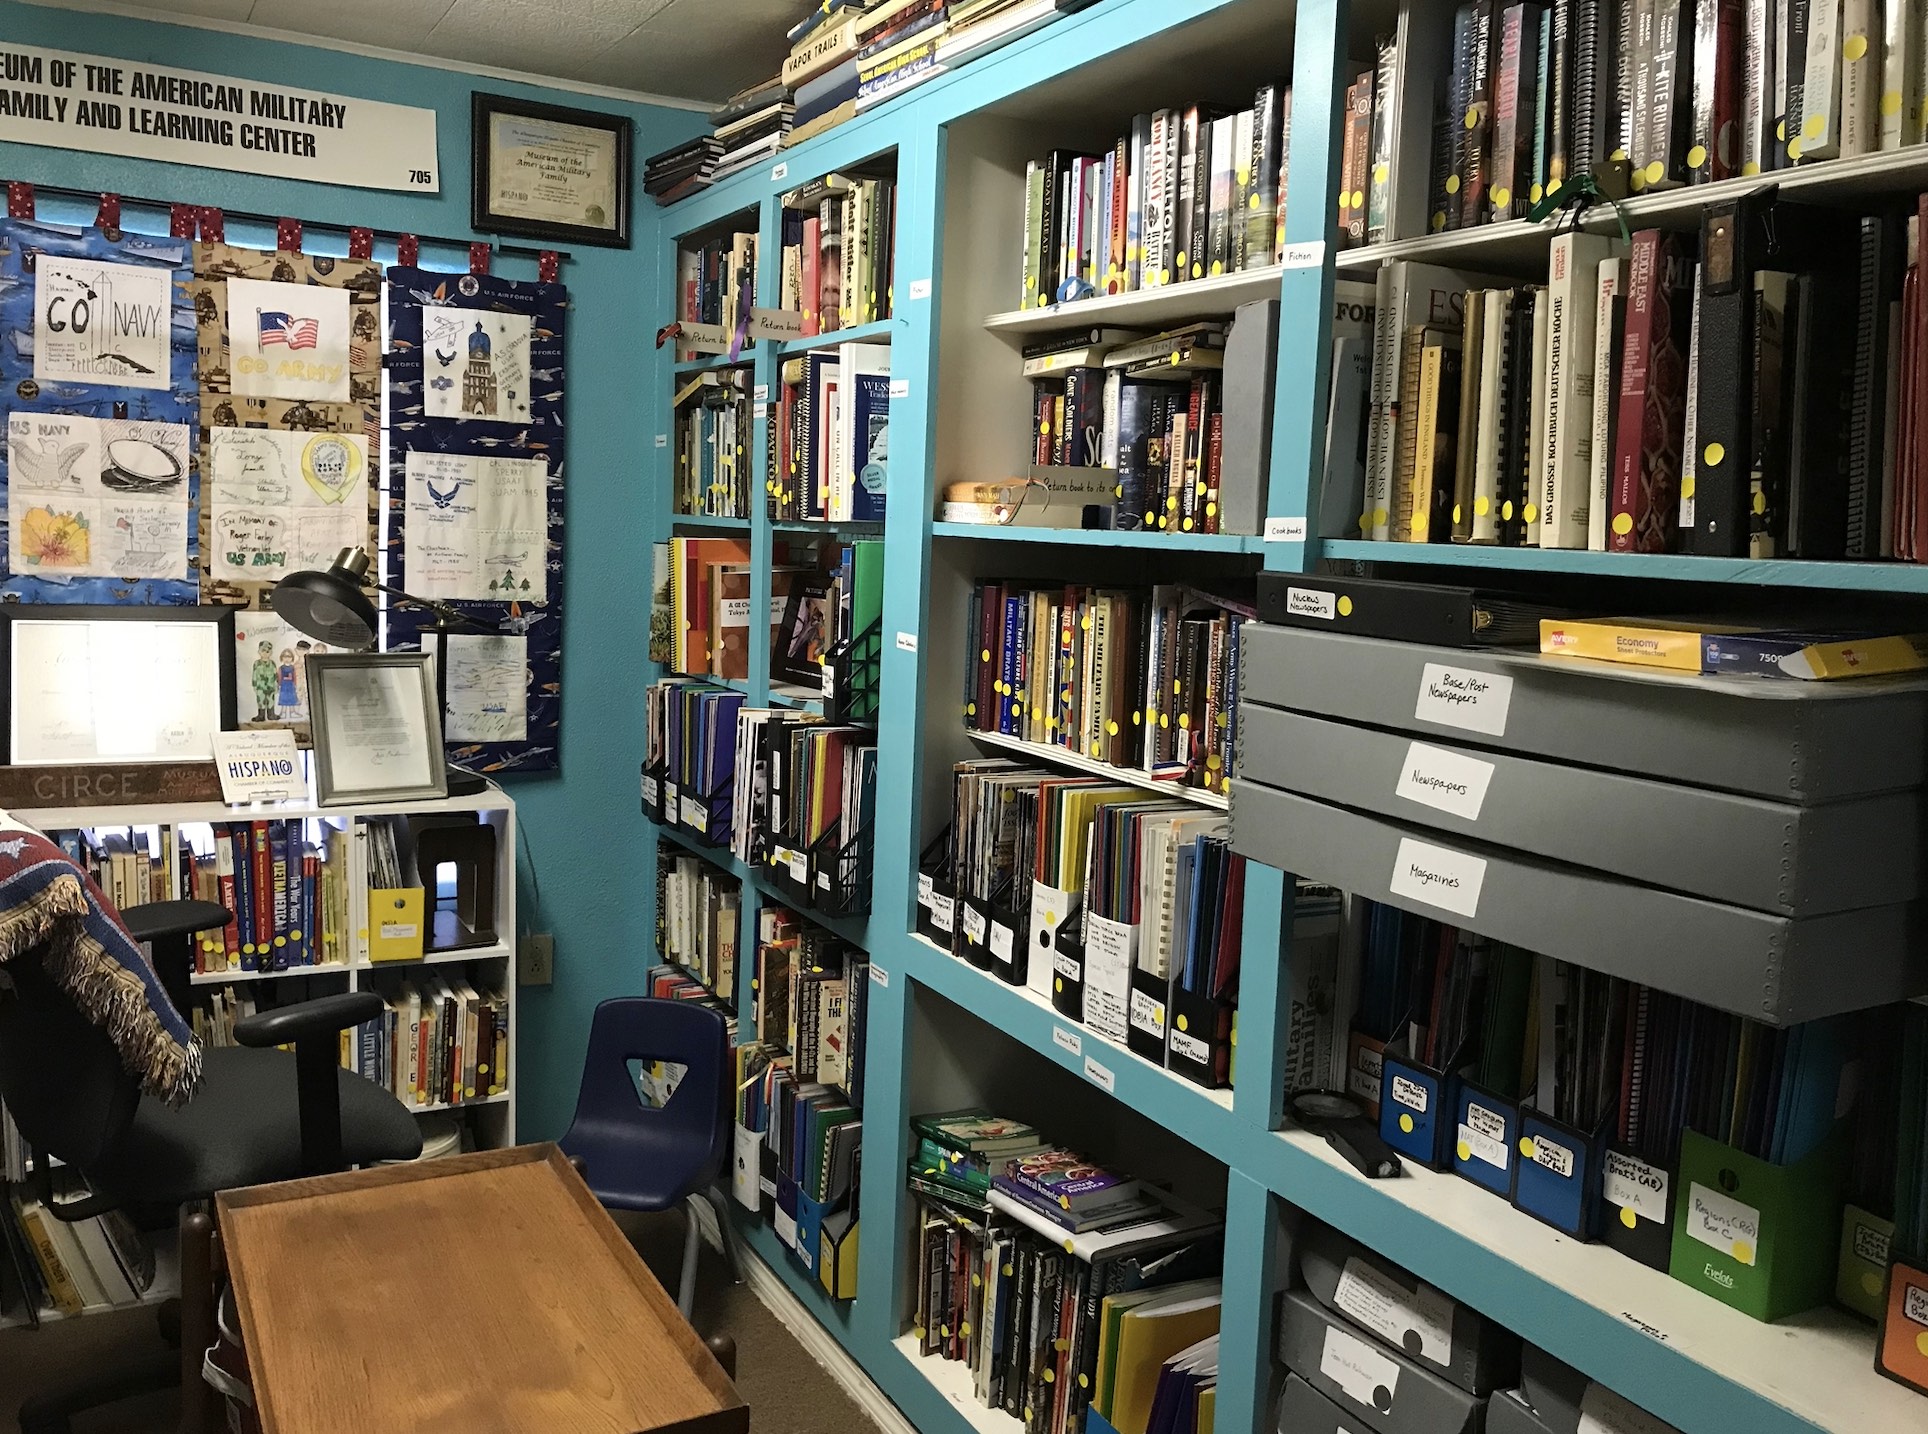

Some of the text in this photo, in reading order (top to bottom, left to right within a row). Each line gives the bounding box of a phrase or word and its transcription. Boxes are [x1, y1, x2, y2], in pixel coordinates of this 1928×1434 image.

[1554, 14, 1568, 42] FURST
[788, 34, 837, 72] VAPOR TRAILS
[1475, 15, 1489, 80] NEWT GINGRICH
[1502, 20, 1519, 118] PEARL HARBOR
[1617, 57, 1632, 101] DOWN
[50, 59, 77, 88] OF
[84, 64, 123, 95] THE
[131, 72, 243, 114] AMERICAN
[250, 90, 346, 129] MILITARY
[1749, 96, 1760, 119] WAR
[1634, 68, 1648, 153] THOUSAND SPLENDID
[1650, 69, 1670, 161] KITE RUNNER
[76, 100, 121, 130] AND
[129, 107, 233, 146] LEARNING
[240, 123, 316, 158] CENTER
[516, 159, 591, 178] American Military
[525, 151, 583, 167] Museum of the
[1469, 146, 1480, 183] TO TRY
[408, 169, 431, 184] 705
[539, 171, 568, 184] Family
[1151, 151, 1162, 200] CLANCY
[1163, 137, 1177, 245] HAMILTON
[1042, 172, 1052, 253] ROAD AHEAD
[1629, 242, 1640, 299] COOKBOOK
[1635, 241, 1651, 313] MIDDLE EAST
[509, 293, 534, 302] FORCE
[114, 301, 162, 338] NAVY
[761, 317, 785, 330] Return
[1372, 308, 1385, 393] DEUTSCHLAND
[237, 355, 343, 384] GO ARMY
[1376, 307, 1397, 500] ESSEN WIE GOTT DEUTSCHLAND
[1425, 386, 1433, 414] THINGS
[10, 421, 71, 435] US NAVY
[1064, 405, 1076, 441] SOLDIERS
[1545, 334, 1561, 525] DAS GROSSE KOCHBUCH DEUTSCHER
[1368, 442, 1378, 461] WIE
[1422, 424, 1430, 460] ENGLAND
[1600, 428, 1609, 463] LUTUING
[1043, 478, 1068, 493] Return
[1070, 480, 1086, 492] book
[1086, 482, 1094, 492] to
[1366, 461, 1377, 498] ESSEN
[1600, 466, 1608, 500] PILIPINO
[1622, 475, 1630, 505] MALLOS
[226, 551, 286, 567] US ARMY
[1290, 602, 1328, 614] Newspapers
[1292, 592, 1319, 604] Nucleus
[1062, 605, 1071, 628] BRATS
[1004, 602, 1014, 682] MILITARY BRATS
[1229, 644, 1238, 667] Army
[1616, 636, 1659, 650] Economy
[1094, 642, 1104, 698] MILITARY
[1228, 668, 1236, 693] Wives
[1443, 673, 1489, 692] Base/Post
[1428, 684, 1478, 705] Newspapers
[1093, 700, 1102, 742] FAMILY
[1225, 701, 1235, 740] American
[228, 759, 293, 778] HISPANO
[1412, 770, 1468, 795] Newspapers
[34, 773, 139, 801] CIRCE
[1409, 864, 1460, 888] Magazines
[1606, 1153, 1653, 1176] Assorted
[1608, 1163, 1664, 1193] Brats (AB)
[1016, 1172, 1062, 1203] Central America
[1613, 1184, 1642, 1206] Box A
[1721, 1229, 1734, 1240] C
[1703, 1263, 1734, 1286] Evelots
